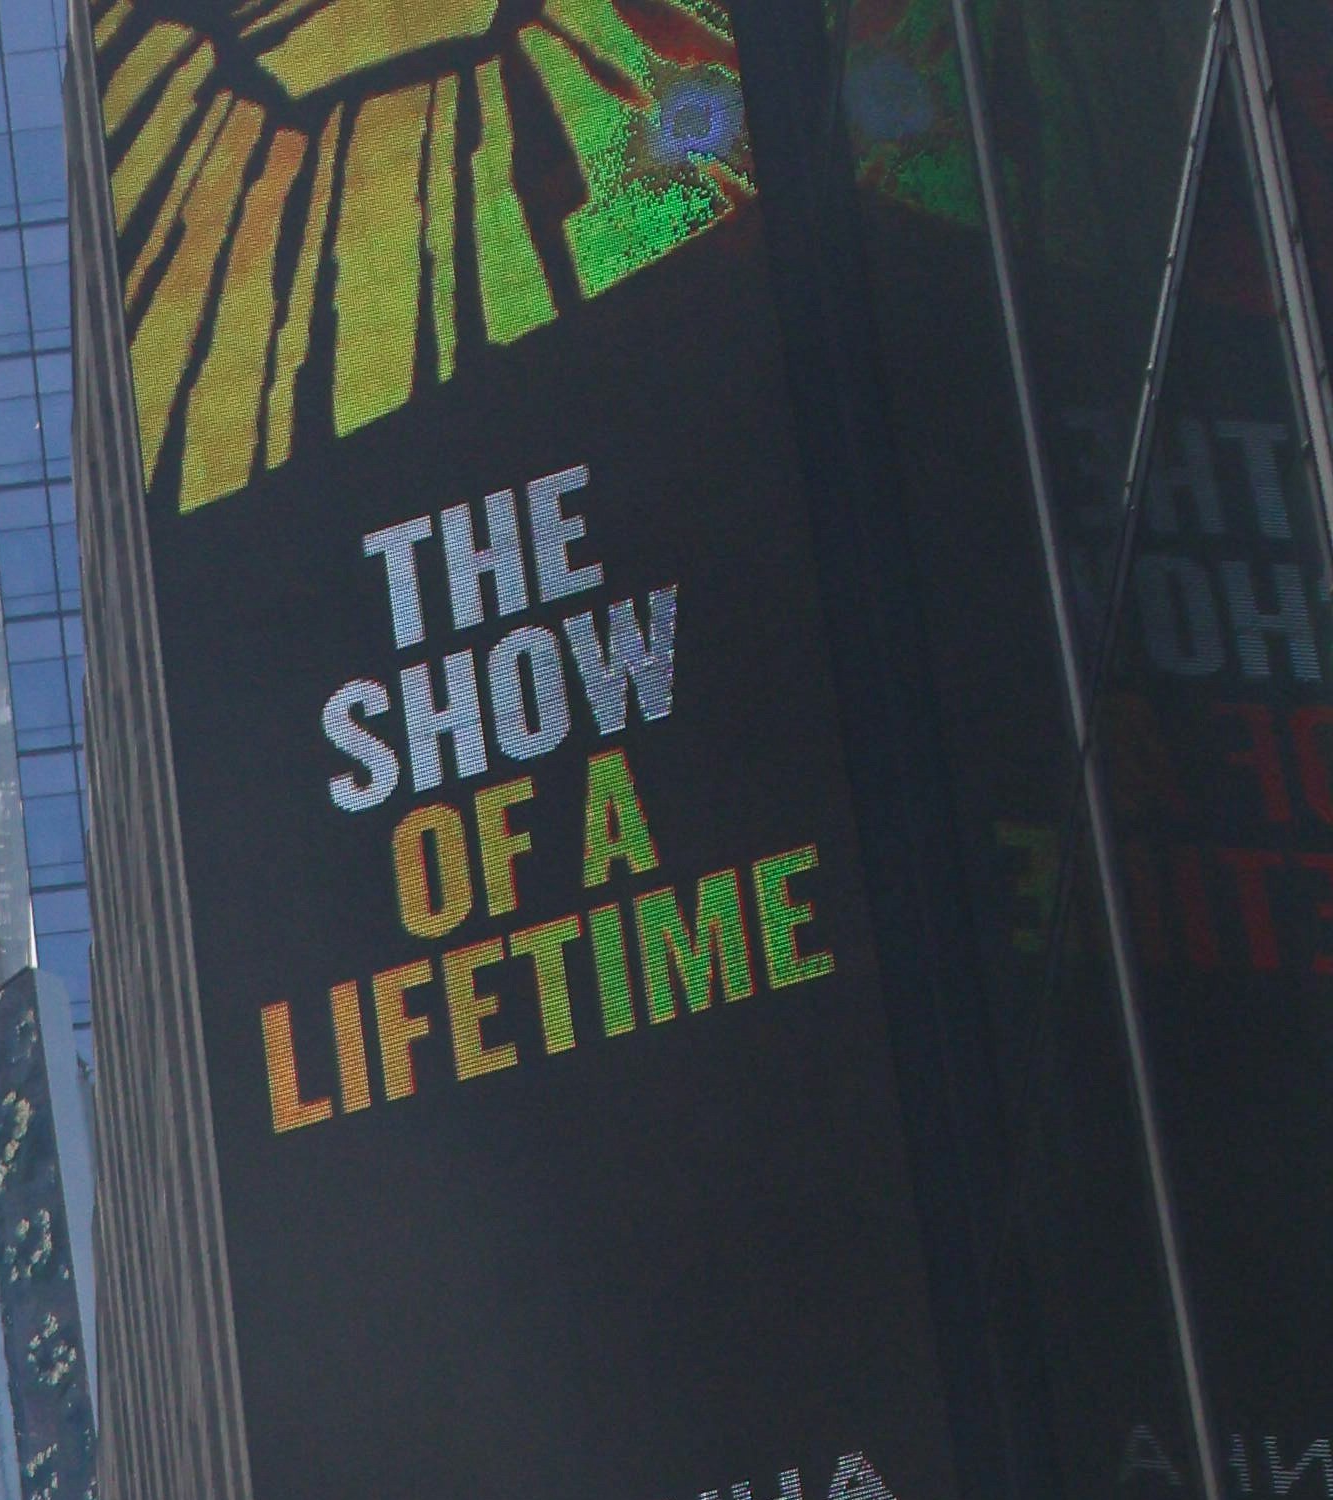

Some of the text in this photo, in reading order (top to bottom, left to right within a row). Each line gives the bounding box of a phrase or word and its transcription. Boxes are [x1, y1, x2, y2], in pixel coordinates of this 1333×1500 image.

[363, 464, 603, 649] THE
[323, 585, 679, 812] SHOW
[392, 749, 658, 937] OF A
[259, 844, 835, 1134] LIFETIME
